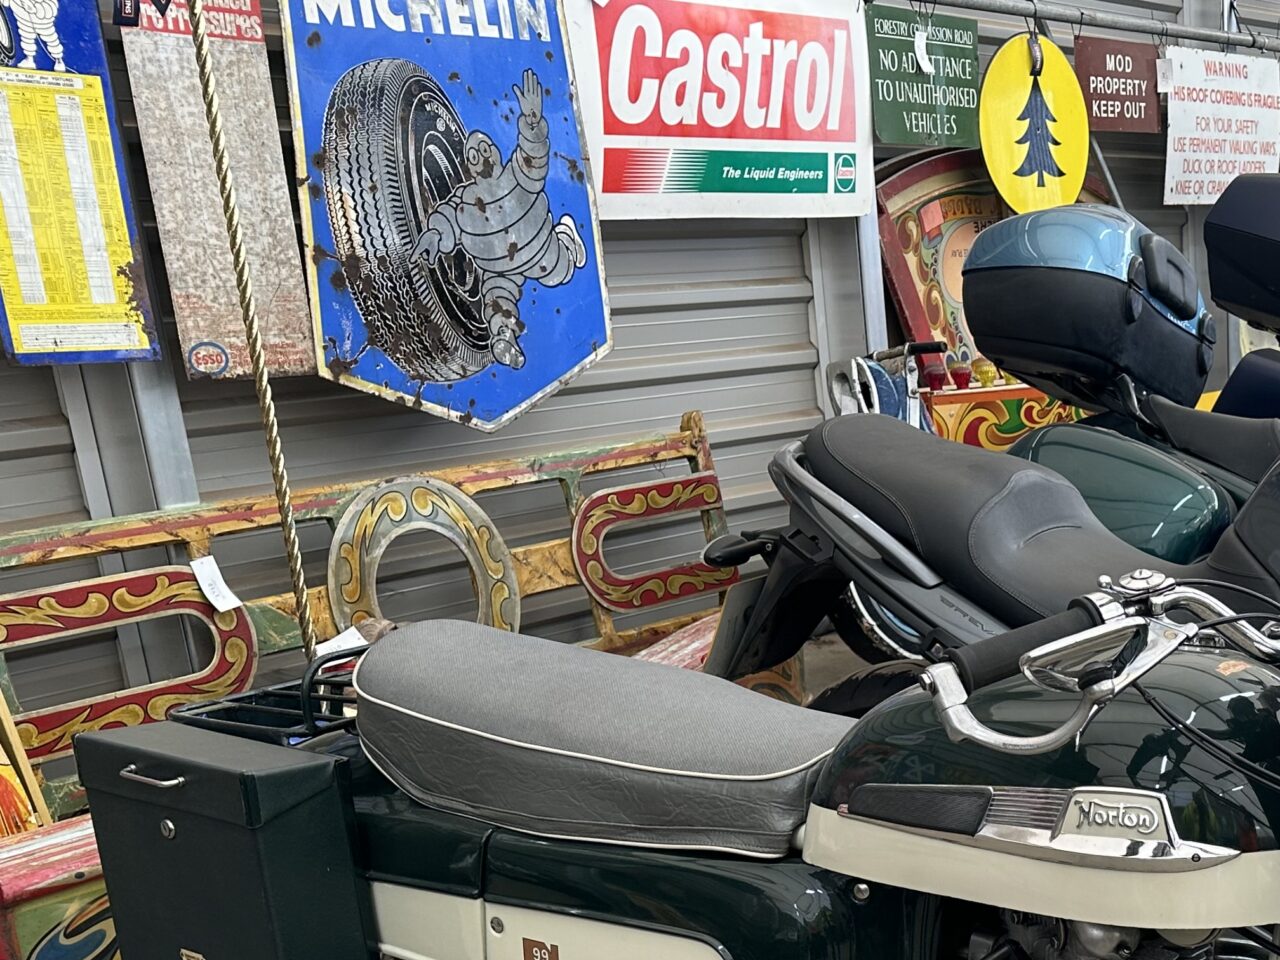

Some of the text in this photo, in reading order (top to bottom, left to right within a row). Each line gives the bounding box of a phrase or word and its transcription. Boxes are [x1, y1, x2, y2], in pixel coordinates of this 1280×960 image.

[303, 0, 551, 41] MICHELIN
[875, 18, 908, 36] FORESTRY
[954, 29, 973, 44] ROAD
[608, 4, 847, 131] Castrol
[879, 48, 898, 72] NO
[1106, 54, 1133, 73] MOD
[1204, 59, 1249, 80] WARNING
[875, 79, 978, 108] TO UNAUTHORISED
[1090, 76, 1147, 97] PROPERTY
[1187, 87, 1209, 103] ROOF
[1211, 89, 1246, 107] COVERING
[1247, 93, 1253, 108] IS
[1254, 93, 1280, 110] FRAGILE
[1092, 100, 1146, 119] KEEP OUT
[903, 111, 957, 136] VEHICLES
[1195, 116, 1259, 135] FOR YOUR SAFETY
[1173, 137, 1187, 153] USE
[1189, 137, 1228, 154] PERMANENT
[1229, 140, 1258, 155] WALKING
[722, 167, 742, 178] The
[743, 167, 775, 180] Liquid
[777, 168, 823, 181] Engineers
[1183, 159, 1266, 174] DUCK OR ROOF LADDERS
[1175, 180, 1192, 195] KNEE
[1193, 180, 1204, 195] OR
[1075, 799, 1159, 834] Norton
